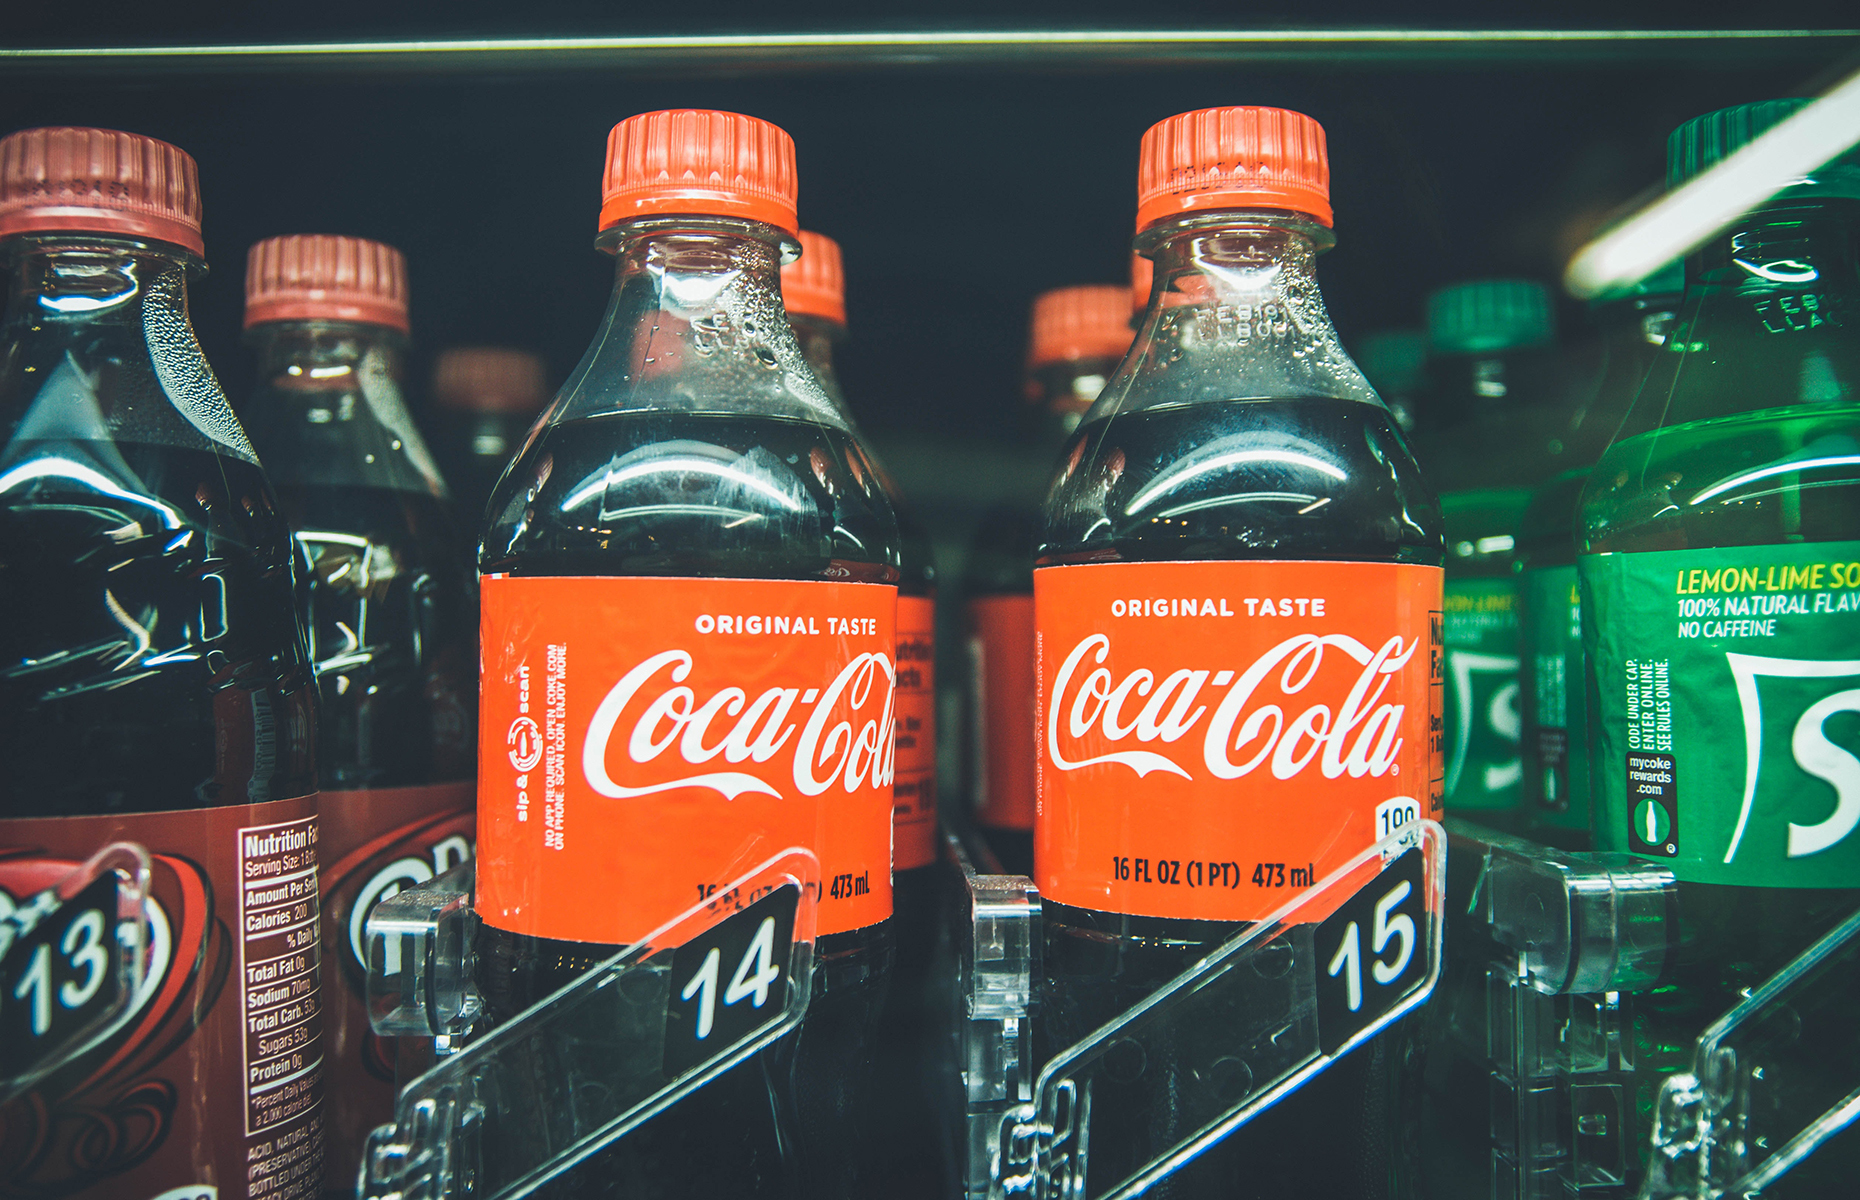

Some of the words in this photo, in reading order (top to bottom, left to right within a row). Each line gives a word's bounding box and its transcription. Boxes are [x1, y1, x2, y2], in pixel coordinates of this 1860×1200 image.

[1676, 563, 1826, 594] LEMON-LIME
[1111, 598, 1234, 617] ORIGINAL
[1244, 598, 1326, 617] TASTE
[1678, 597, 1720, 617] 100%
[1724, 594, 1809, 616] NATURAL
[695, 614, 820, 634] ORIGINAL
[828, 617, 876, 635] TASTE
[1678, 621, 1700, 638] NO
[1703, 619, 1777, 638] CAFFEINE
[547, 644, 557, 706] COKE.COM
[556, 642, 567, 679] MORE.
[1626, 658, 1638, 681] CAP.
[519, 666, 530, 713] scan
[1640, 659, 1654, 708] ONLINE.
[1655, 658, 1669, 699] ONLINE.
[556, 680, 567, 718] ENJOY
[1048, 633, 1419, 781] Coca-Cola
[1627, 683, 1639, 720] UNDER
[546, 708, 556, 740] OPEN
[1656, 700, 1671, 732] RULES
[1628, 722, 1640, 749] CODE
[1642, 712, 1655, 750] ENTER
[1657, 733, 1671, 751] SEE
[555, 754, 565, 786] SCAN
[1629, 757, 1672, 770] mycoke
[1630, 770, 1672, 783] rewards
[516, 774, 528, 789] &
[1636, 783, 1662, 795] .com
[516, 792, 530, 822] sip
[545, 804, 556, 828] APP
[245, 829, 307, 858] Nutrition
[545, 829, 555, 847] NO
[554, 833, 565, 850] ON
[245, 858, 282, 877] Serving
[283, 855, 300, 870] Size:
[1113, 856, 1130, 880] 16
[1135, 858, 1152, 883] FL
[1157, 860, 1180, 884] OZ
[1186, 860, 1203, 888] (1
[1209, 861, 1240, 889] PT)
[1252, 863, 1285, 888] 473
[246, 884, 289, 908] Amount
[290, 882, 304, 897] Per
[830, 873, 853, 900] 473
[855, 870, 870, 896] mL
[246, 910, 291, 932] Calories
[294, 903, 308, 920] 200
[287, 933, 296, 948] %
[297, 927, 313, 945] Daily
[1328, 880, 1416, 1012] 15
[14, 909, 108, 1036] 13
[247, 962, 277, 984] Total
[280, 957, 295, 976] Fat
[296, 956, 305, 971] 0g
[682, 916, 780, 1039] 14
[248, 986, 290, 1009] Sodium
[291, 978, 311, 996] 70mg
[249, 1011, 279, 1033] Total
[281, 1004, 303, 1024] Carb.
[259, 1033, 293, 1055] Sugars
[294, 1026, 308, 1043] 53g
[250, 1058, 290, 1083] Protein
[292, 1053, 302, 1069] 0g
[248, 1169, 290, 1197] BOTTLED
